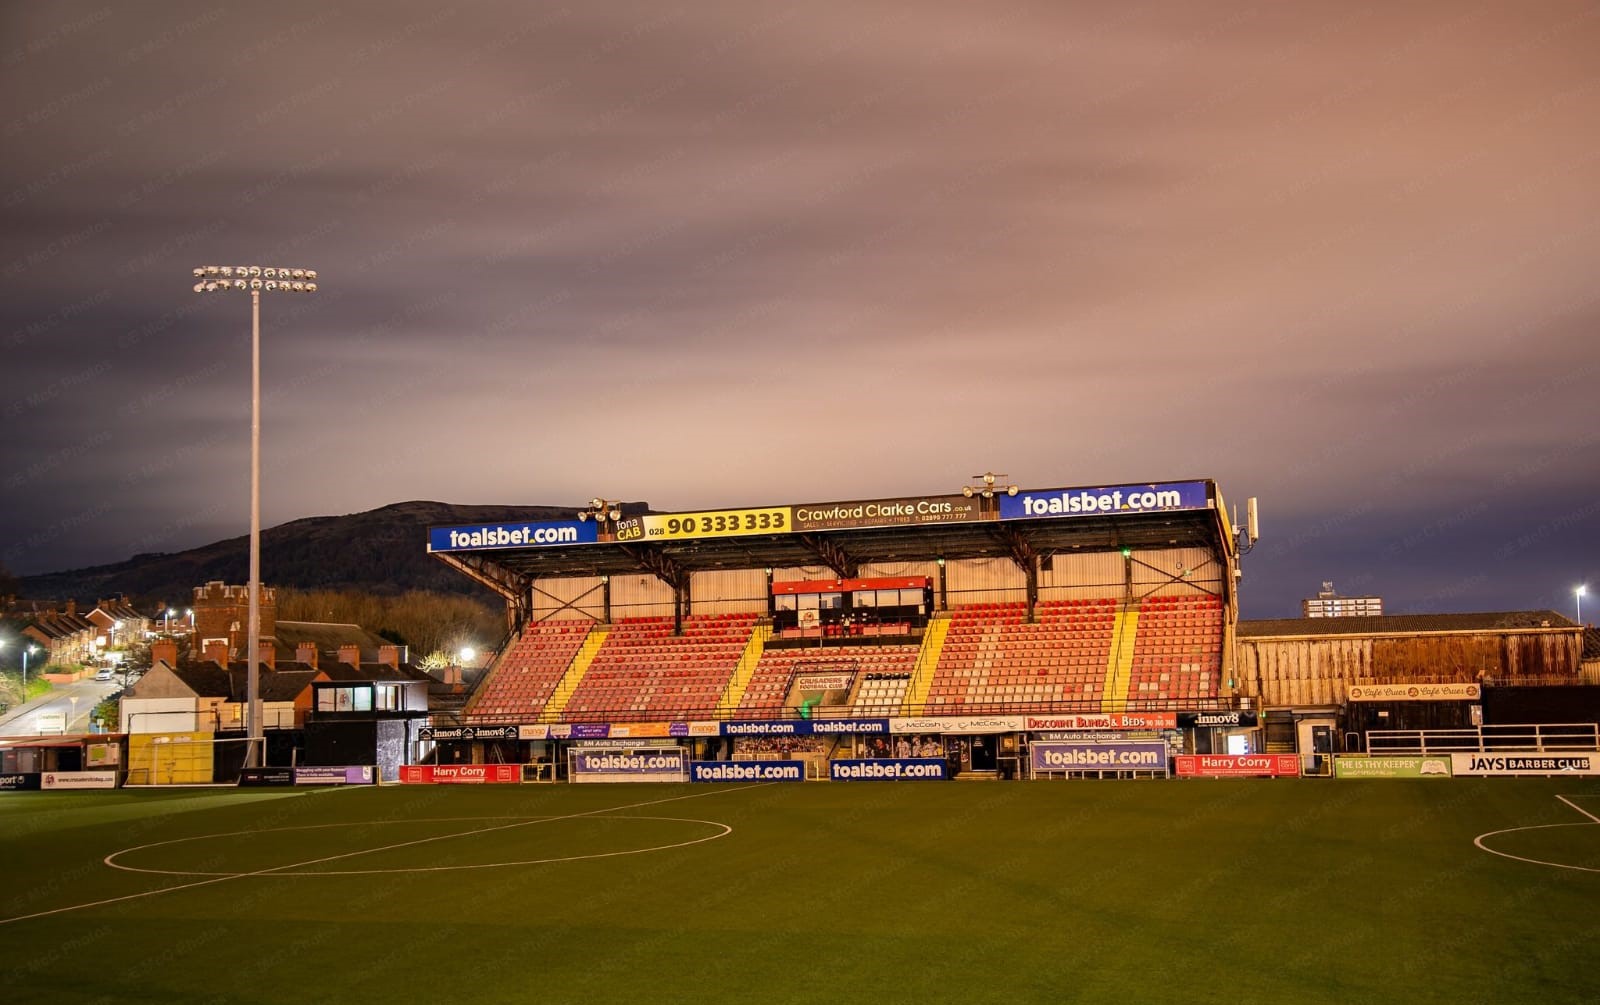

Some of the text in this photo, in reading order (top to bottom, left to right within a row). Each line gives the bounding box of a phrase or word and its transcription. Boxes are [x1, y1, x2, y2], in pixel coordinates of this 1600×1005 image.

[1023, 490, 1181, 515] toalsbet.com
[796, 506, 863, 522] Crawford
[865, 502, 915, 517] Clarke
[917, 501, 952, 514] Cars
[616, 518, 638, 531] fona
[649, 512, 785, 536] 028 90 333 333
[450, 526, 577, 547] toalsbet.com
[616, 526, 642, 540] CAB
[800, 677, 843, 685] CRUSADERS
[1362, 687, 1382, 698] Café
[1420, 686, 1440, 697] Café
[813, 722, 883, 733] toalsbet.com
[1027, 717, 1075, 728] DISCOUNT
[1075, 716, 1110, 728] BLINDS
[1111, 719, 1119, 727] &
[1122, 715, 1145, 727] BEDS
[726, 723, 794, 734] toalsbet.com
[1082, 732, 1122, 740] Exchange
[612, 739, 645, 747] Exchange
[584, 754, 681, 769] toalsbet.com
[1044, 748, 1158, 764] toalsbet.com
[1202, 757, 1272, 769] Harry Corry
[1355, 761, 1363, 769] IS
[1364, 761, 1384, 769] THY
[1509, 760, 1556, 768] BARBER
[1557, 759, 1590, 768] CLUB
[433, 767, 486, 777] Harry Corry
[695, 764, 800, 779] toalsbet.com
[833, 762, 942, 778] toalsbet.com
